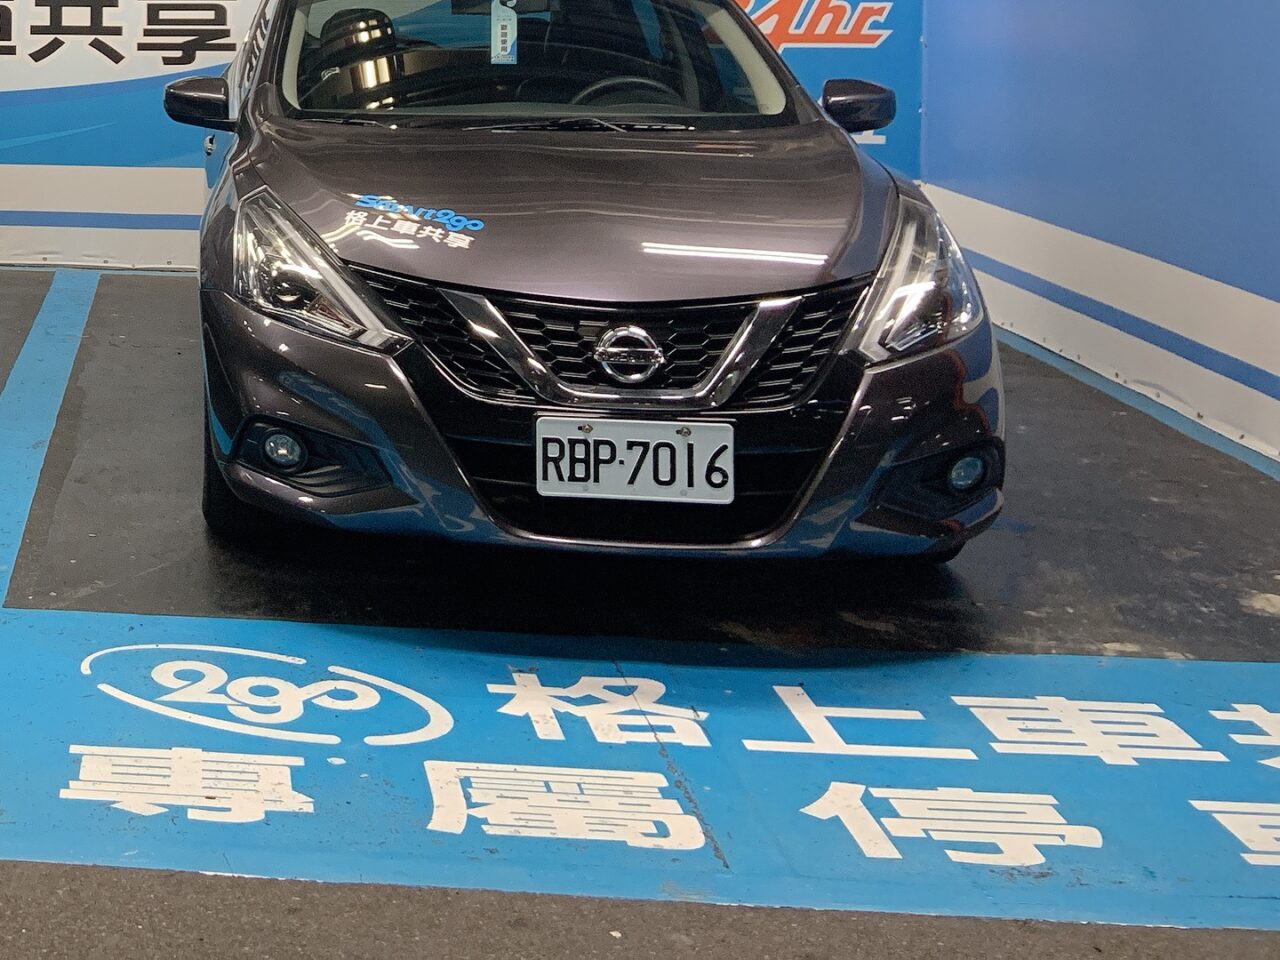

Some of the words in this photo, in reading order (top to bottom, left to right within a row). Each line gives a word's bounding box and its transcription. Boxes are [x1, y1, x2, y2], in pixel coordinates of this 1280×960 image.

[344, 209, 476, 249] 格上車共享
[541, 436, 729, 489] RBP-7016
